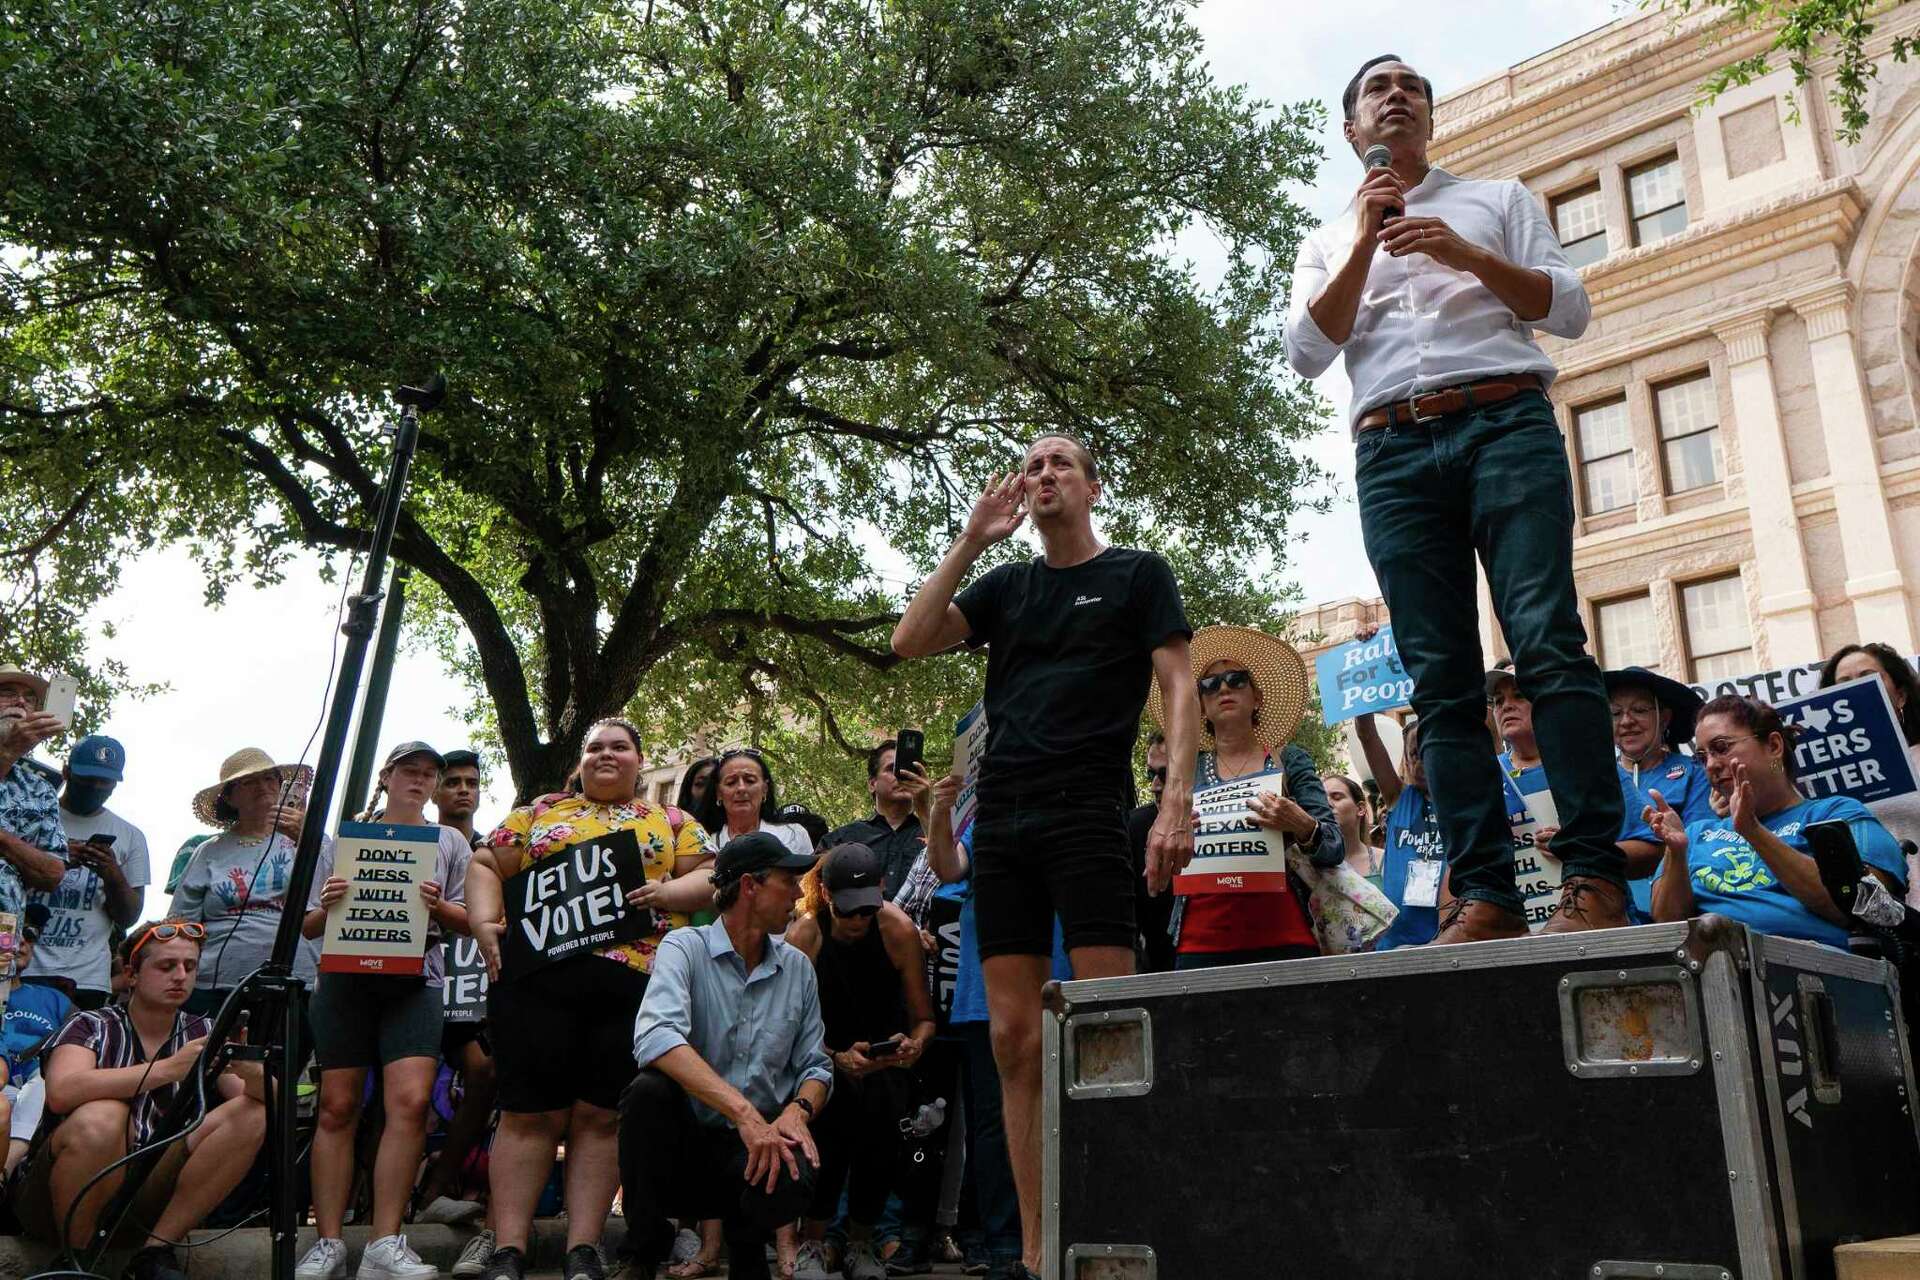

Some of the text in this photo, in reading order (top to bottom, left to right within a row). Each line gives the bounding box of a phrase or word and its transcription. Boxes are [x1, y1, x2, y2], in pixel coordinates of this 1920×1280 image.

[1342, 634, 1398, 671] Ral
[1336, 665, 1378, 691] For
[1694, 661, 1828, 703] OTEC
[1342, 679, 1415, 711] Peop
[1794, 728, 1871, 768] TERS
[1796, 758, 1886, 798] TTER
[1199, 790, 1254, 805] MESS
[1202, 803, 1249, 814] WITH
[1513, 832, 1534, 847] SS
[358, 848, 413, 862] DON'T
[1515, 856, 1536, 872] TH
[358, 868, 410, 882] MESS
[524, 845, 617, 913] LET US
[359, 888, 404, 901] WITH
[349, 908, 409, 922] TEXAS
[520, 883, 625, 951] VOTE!
[1525, 903, 1557, 921] ERS
[43, 916, 84, 937] JAS
[340, 928, 412, 942] VOTERS
[547, 930, 616, 957] POWERED BY PEOPLE
[442, 974, 489, 1006] TE!
[4, 1010, 53, 1031] COUNTY
[451, 1009, 473, 1017] PEOPLE
[1770, 991, 1812, 1128] AUX
